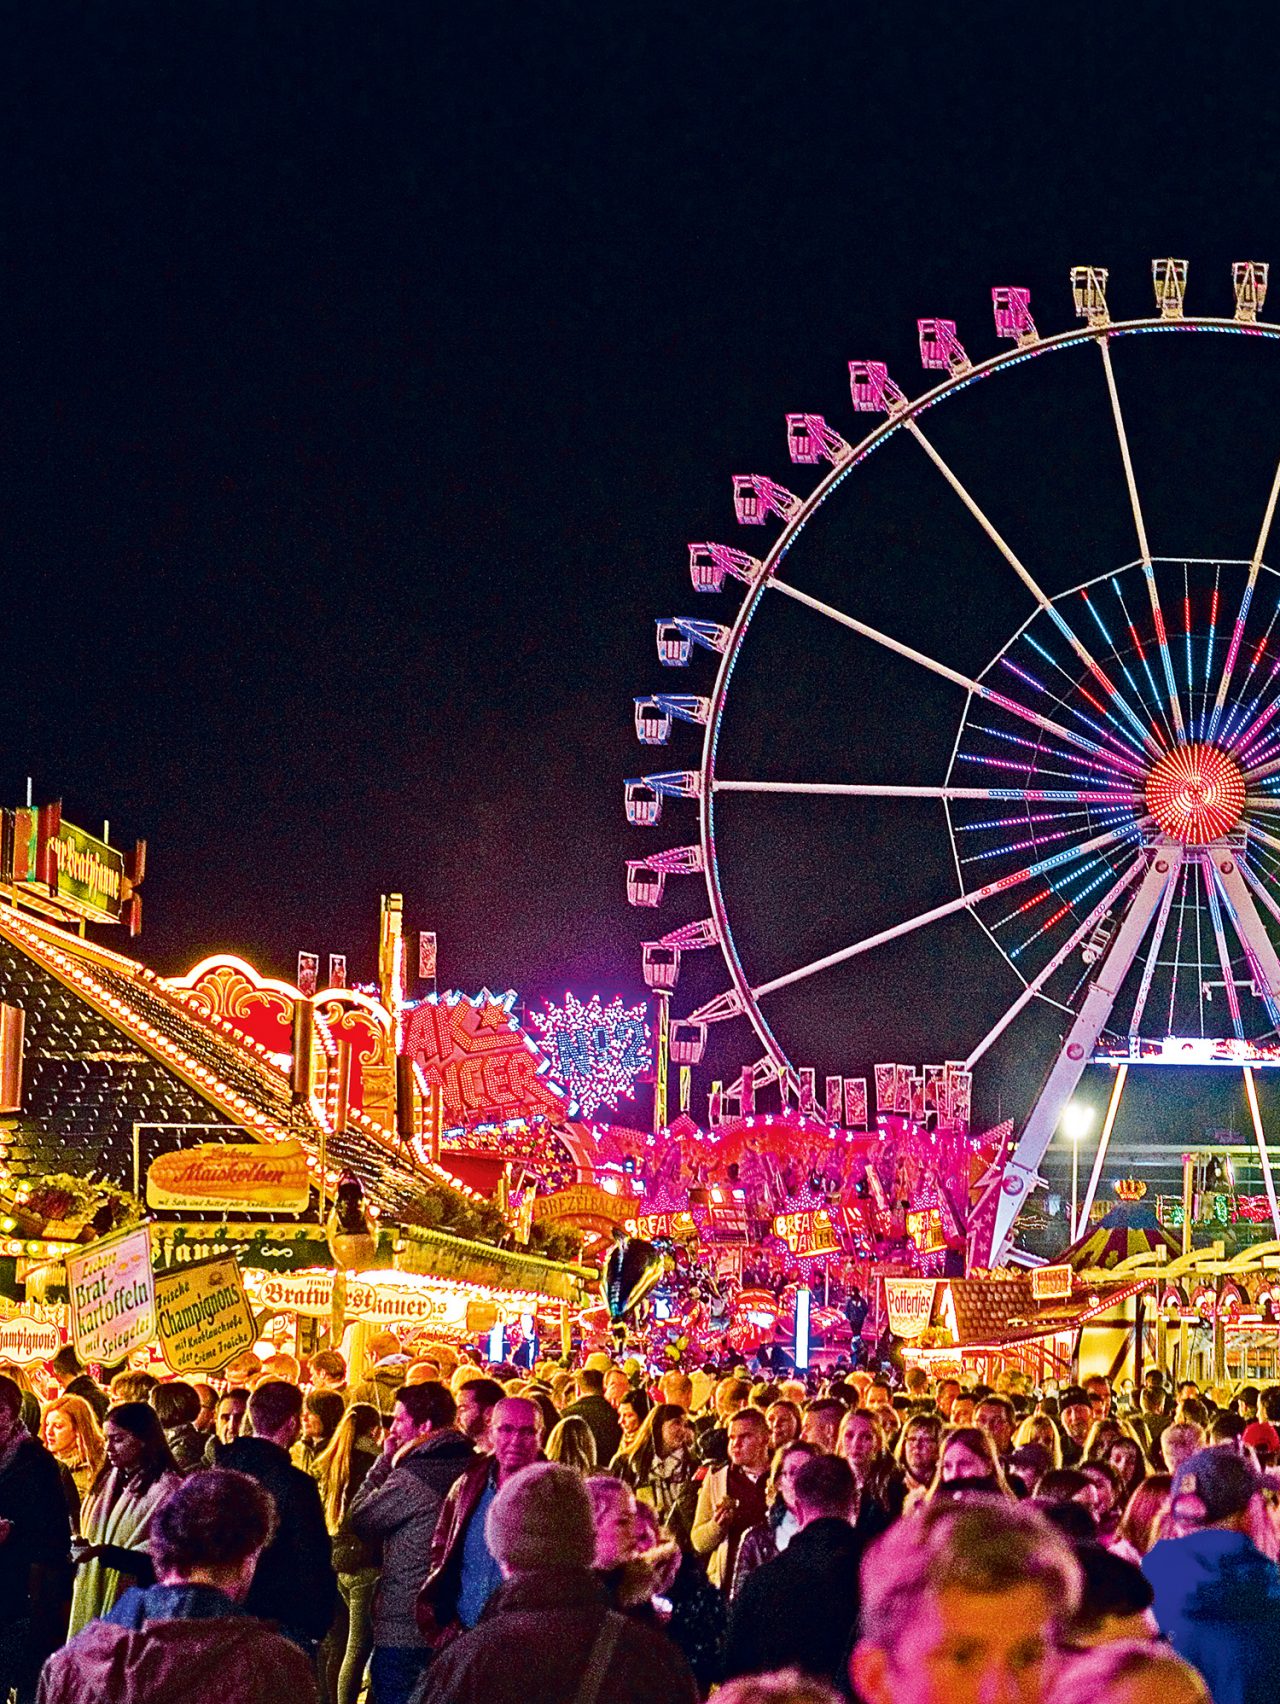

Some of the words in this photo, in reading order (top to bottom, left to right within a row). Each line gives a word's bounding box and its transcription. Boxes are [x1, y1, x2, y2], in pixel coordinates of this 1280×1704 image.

[174, 1162, 285, 1184] Maiskolben
[265, 1283, 374, 1308] Bratwrst
[889, 1290, 930, 1318] Poffertjes
[159, 1283, 240, 1339] Champignons
[0, 1327, 56, 1355] ampignons
